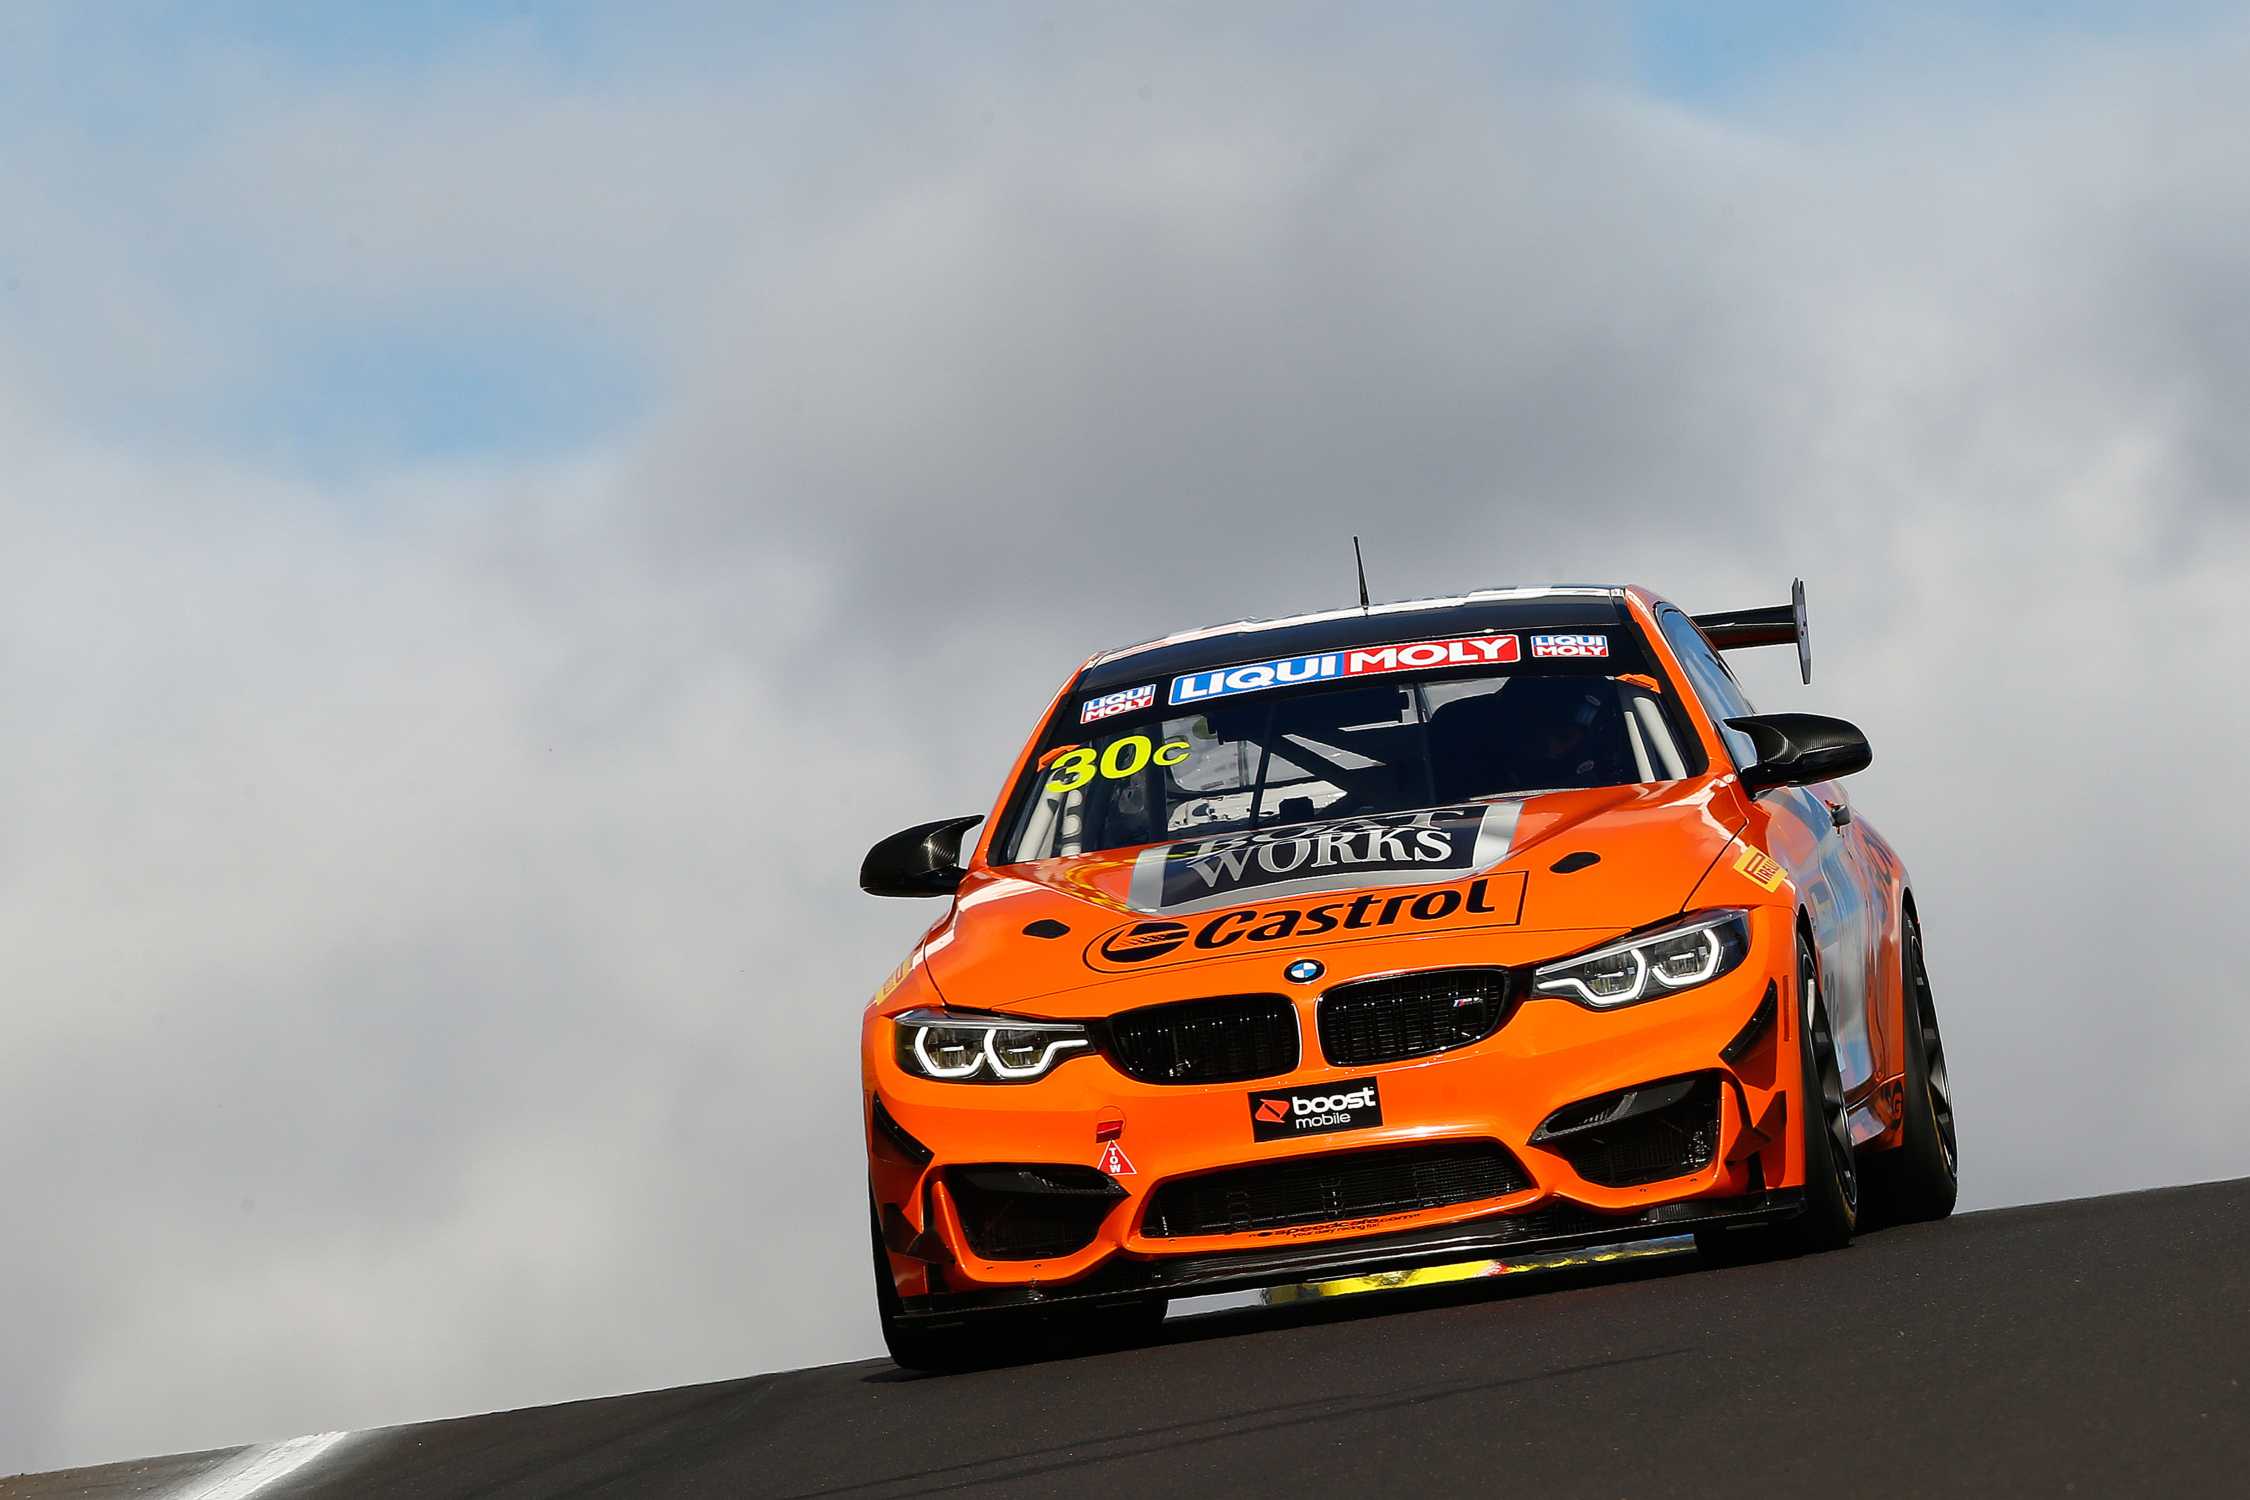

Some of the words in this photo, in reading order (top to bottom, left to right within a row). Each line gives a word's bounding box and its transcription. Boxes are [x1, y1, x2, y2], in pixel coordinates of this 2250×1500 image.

[1534, 636, 1603, 646] LIQUI
[1536, 646, 1606, 656] MOLY
[1178, 655, 1337, 698] LIQUI
[1349, 636, 1515, 673] MOLY
[1085, 695, 1153, 722] MOLY
[1086, 685, 1152, 711] LIQUI
[1186, 827, 1453, 888] WORKS
[1193, 879, 1496, 950] Castrol
[1292, 1087, 1376, 1116] boost
[1295, 1112, 1352, 1129] mobile
[1108, 1147, 1121, 1173] TOW
